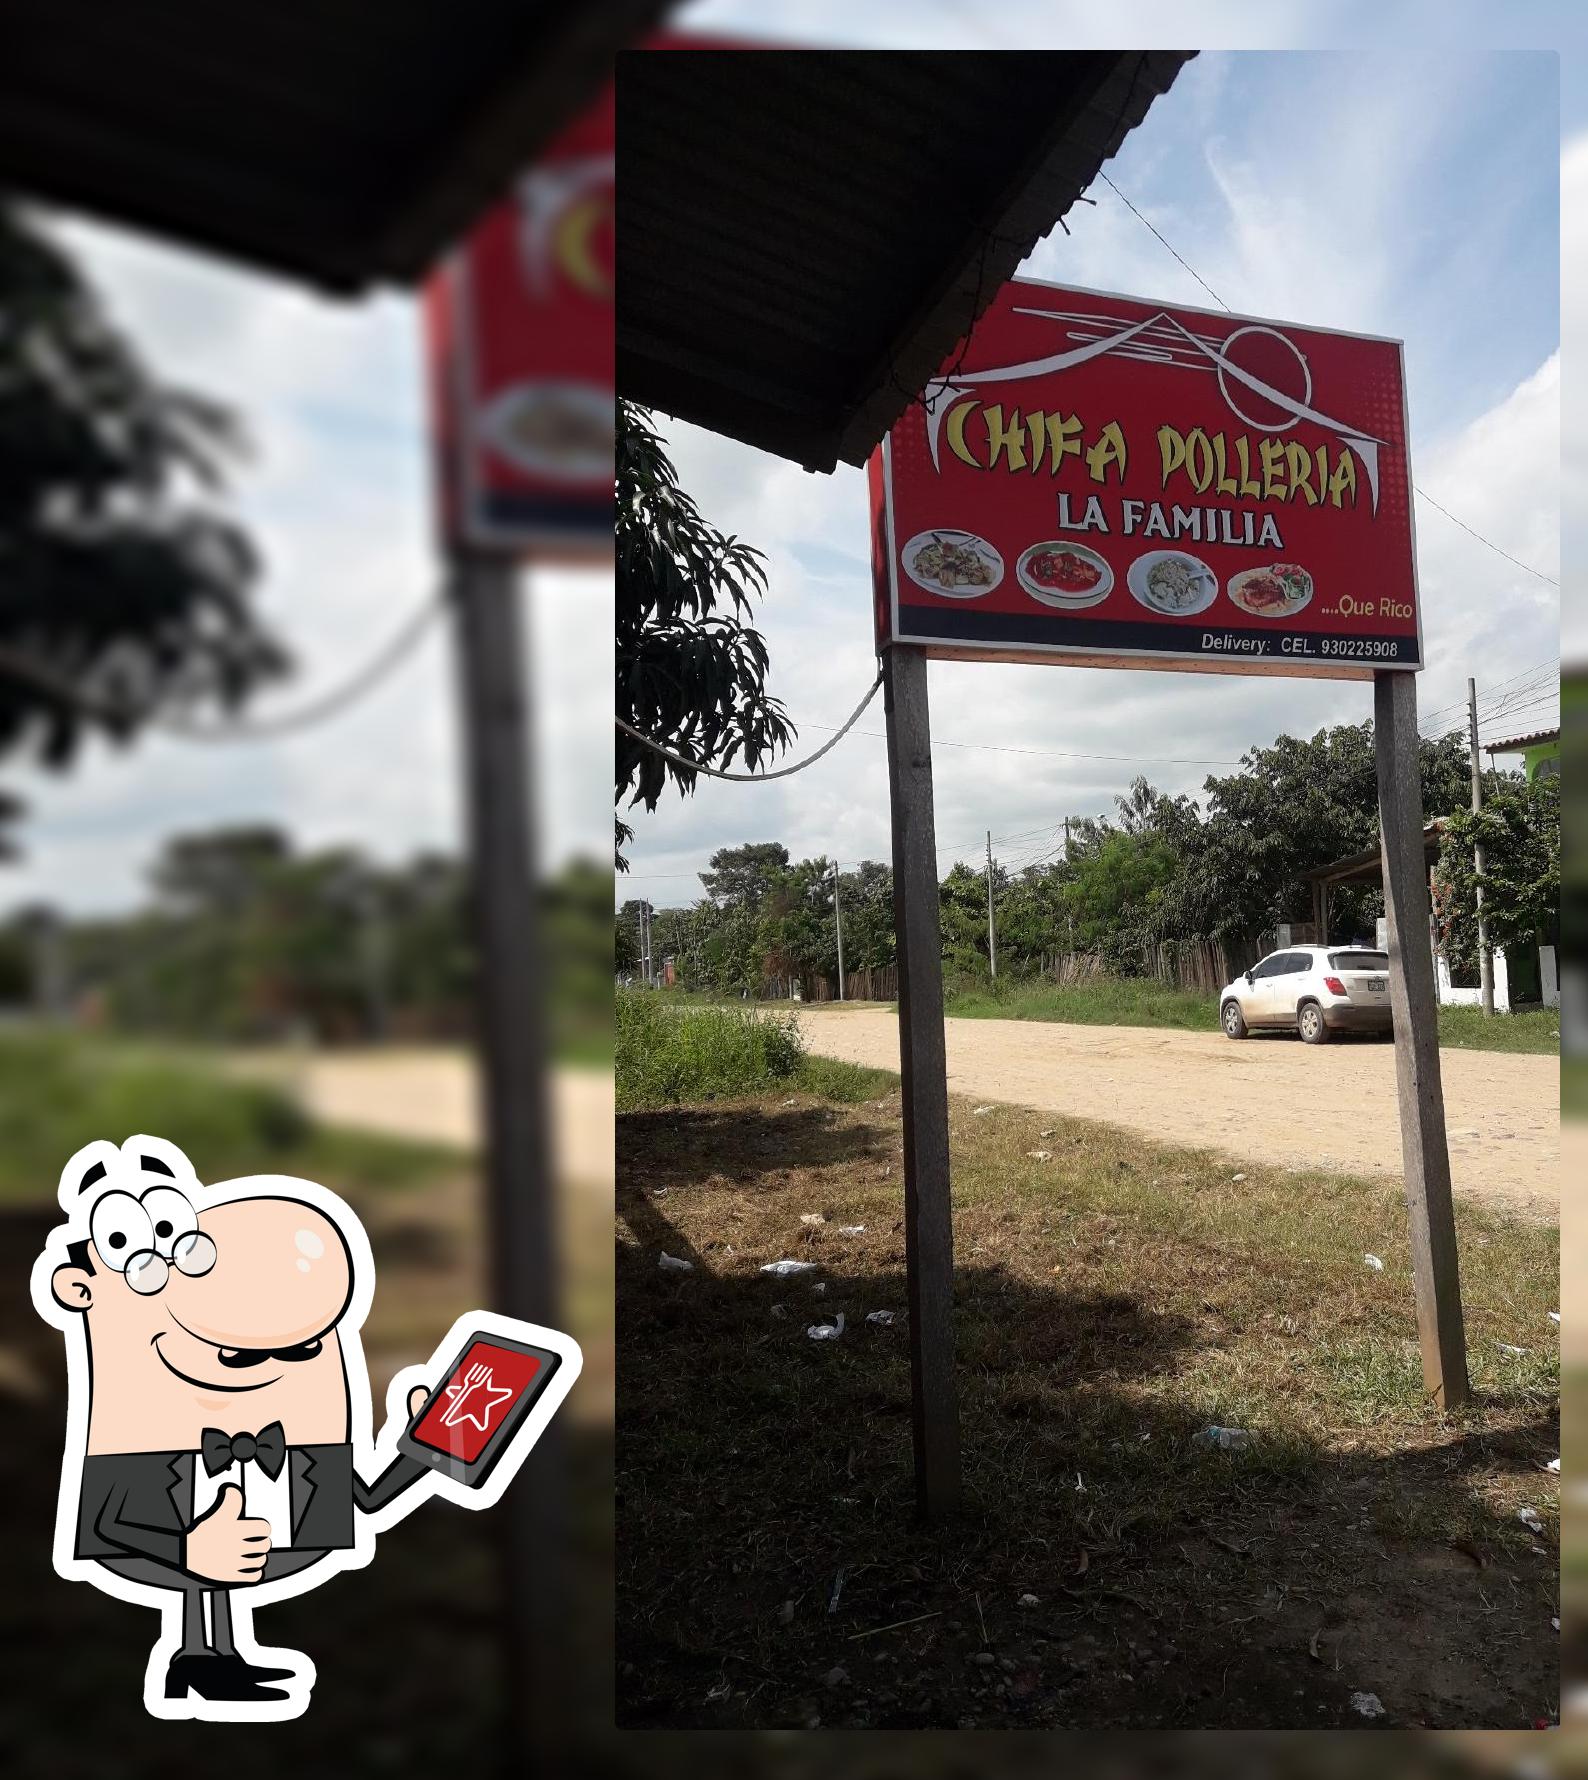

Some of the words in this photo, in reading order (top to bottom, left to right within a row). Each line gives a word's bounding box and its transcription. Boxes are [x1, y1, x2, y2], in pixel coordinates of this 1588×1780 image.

[946, 400, 1129, 485] CHIFA
[1156, 424, 1358, 507] POLLERIA
[1057, 492, 1107, 533] LA
[1121, 499, 1285, 549] FAMILIA
[1379, 597, 1413, 618] Rico
[1201, 633, 1271, 656] Delivery:
[1281, 637, 1316, 654] CEL.
[1321, 639, 1398, 657] 930225908
